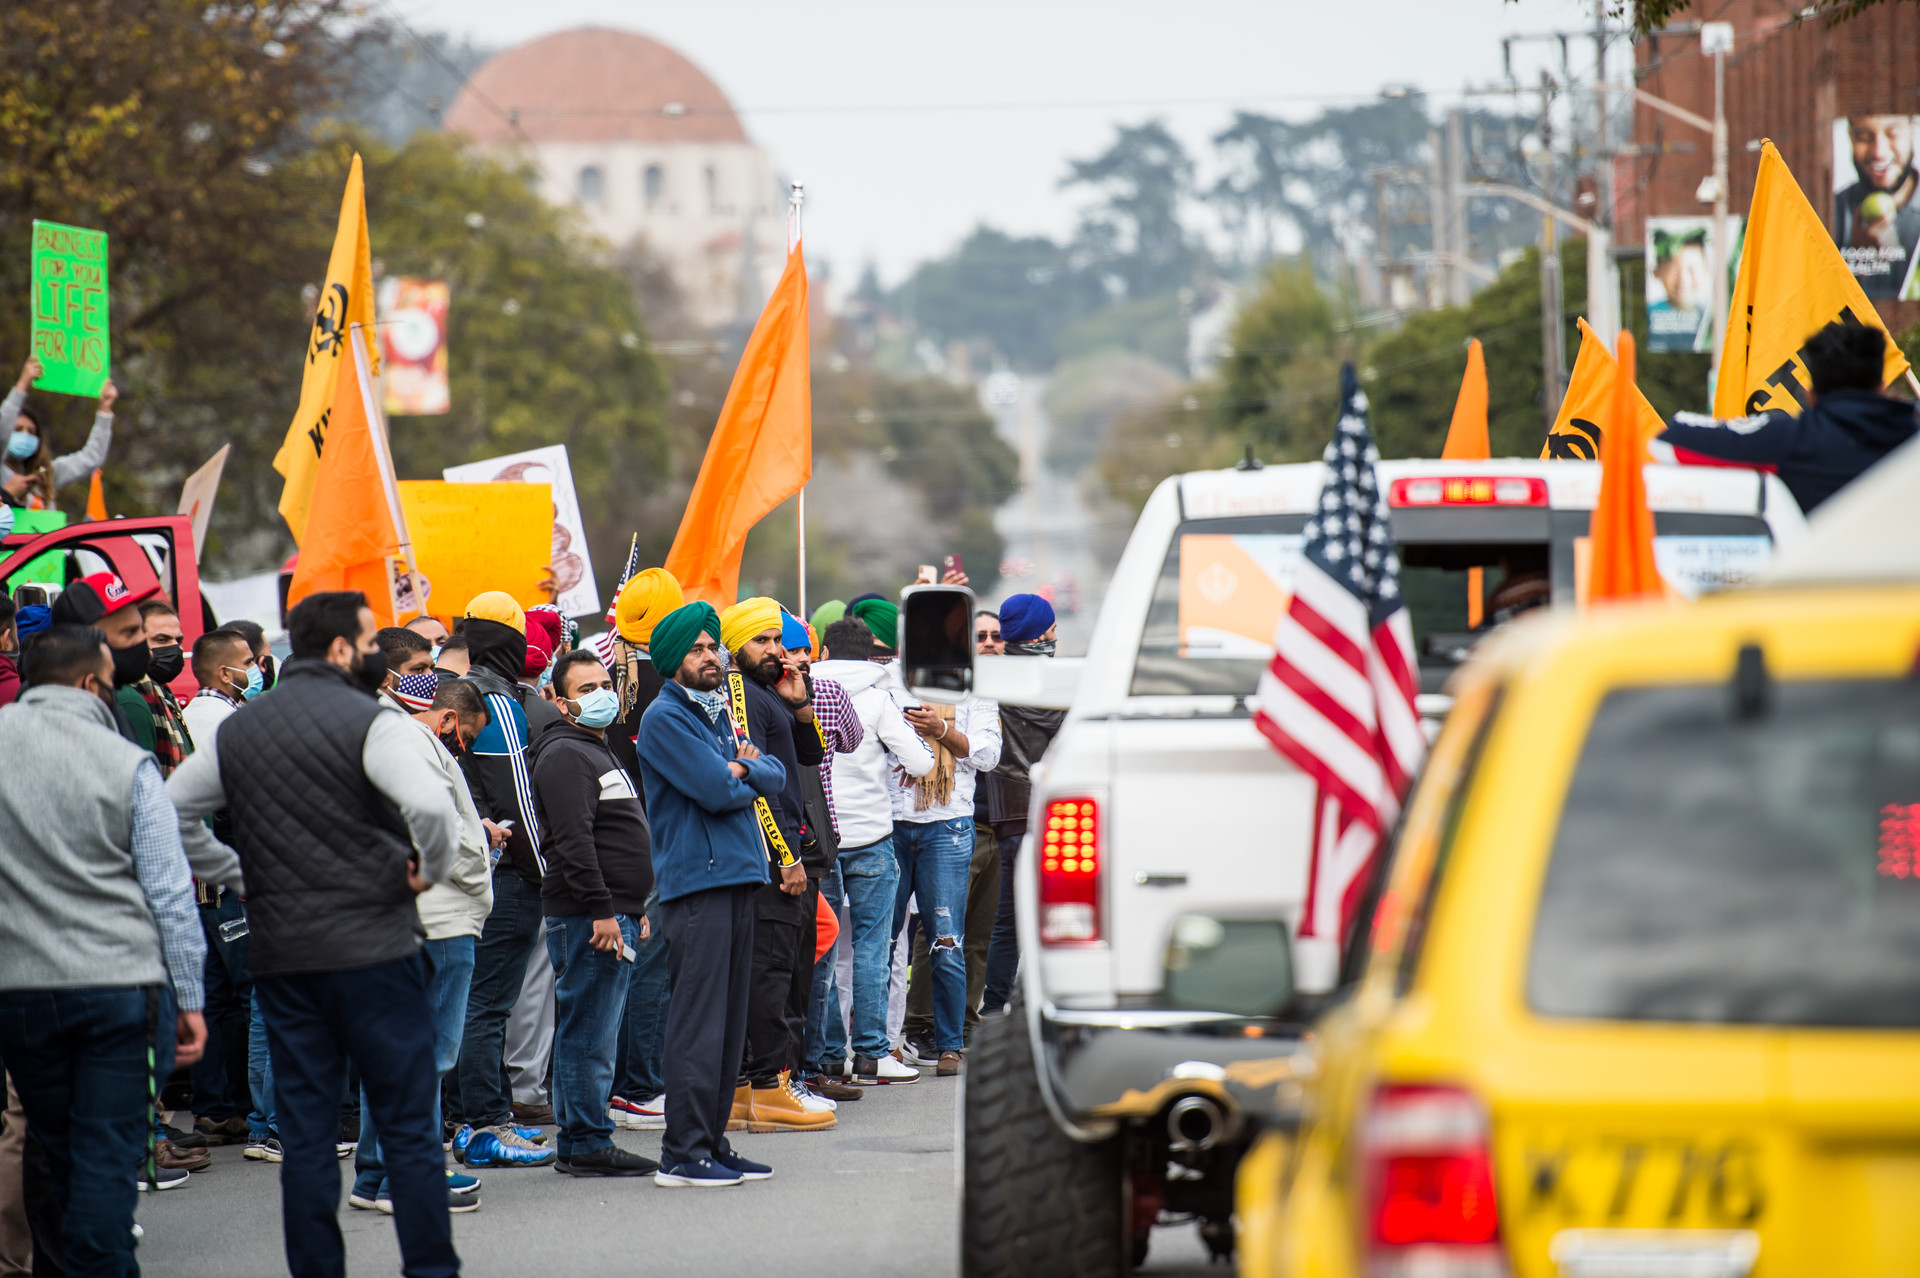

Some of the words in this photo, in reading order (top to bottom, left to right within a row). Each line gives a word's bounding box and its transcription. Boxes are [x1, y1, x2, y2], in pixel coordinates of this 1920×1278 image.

[35, 281, 102, 332] LIFE
[35, 329, 68, 363] FOR
[72, 334, 103, 373] US
[1522, 1134, 1768, 1226] K776
